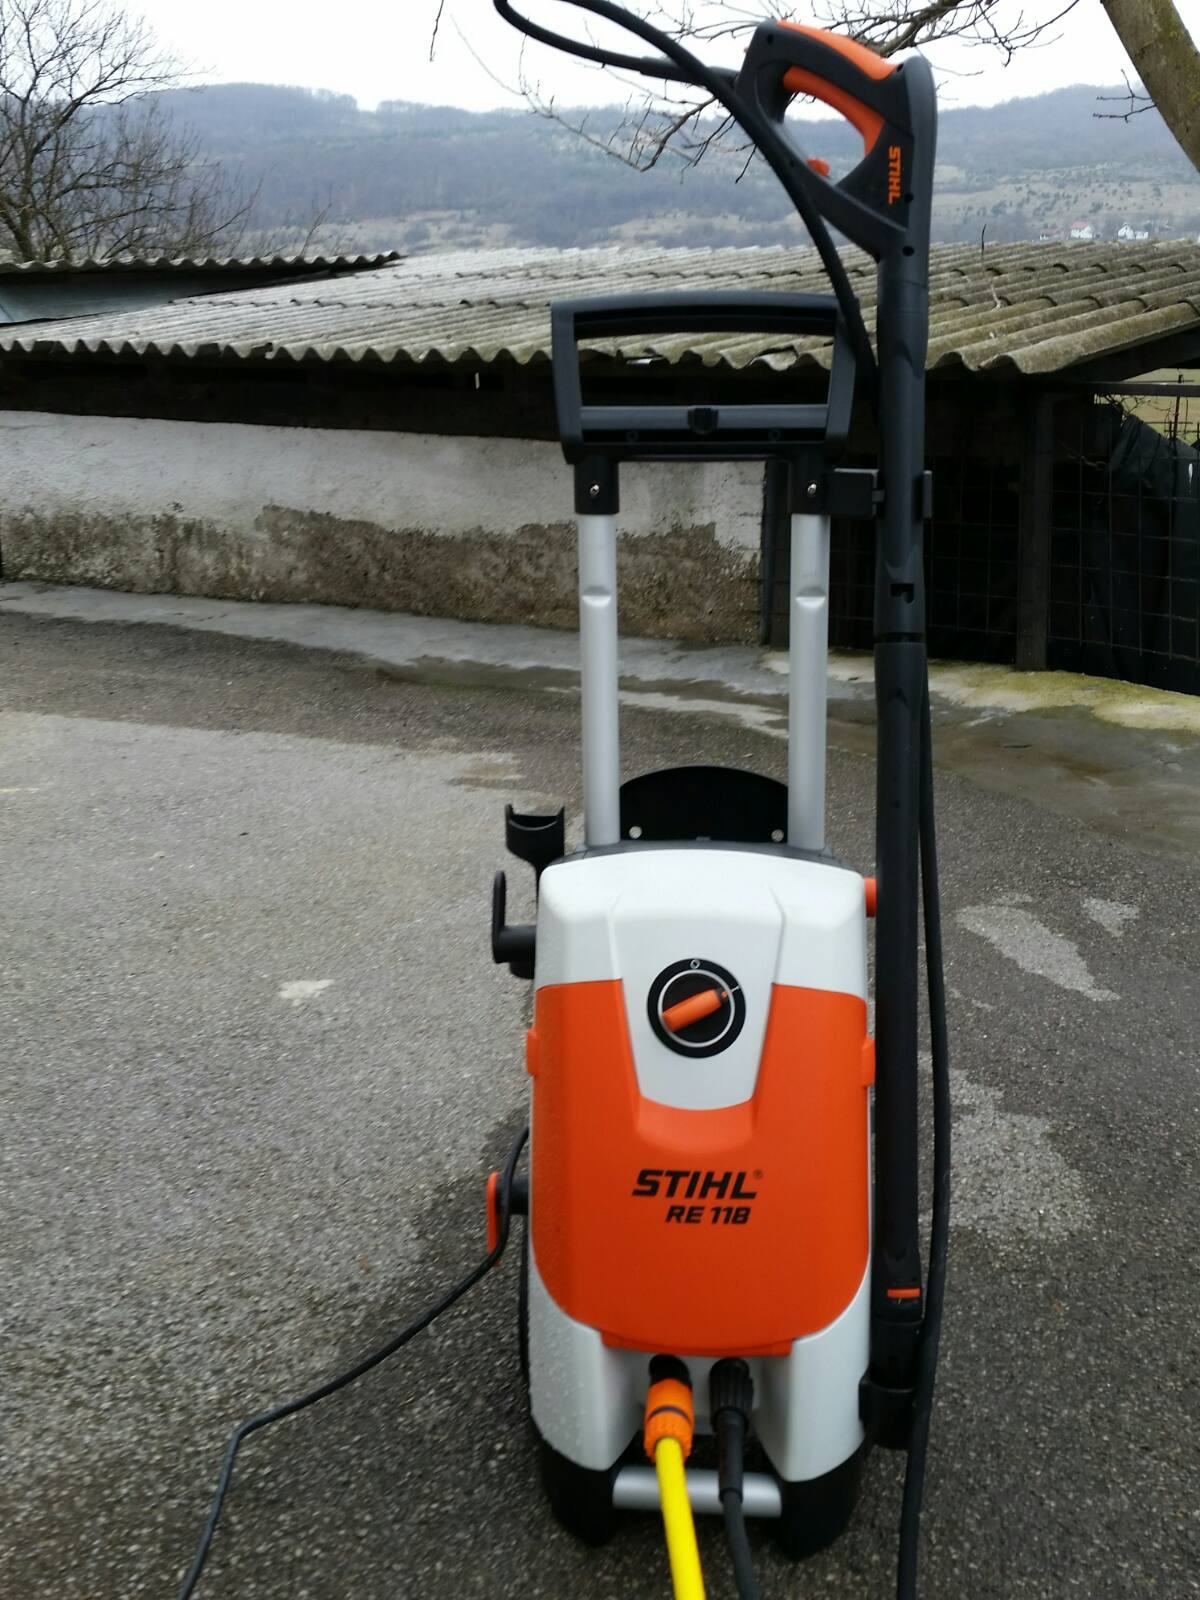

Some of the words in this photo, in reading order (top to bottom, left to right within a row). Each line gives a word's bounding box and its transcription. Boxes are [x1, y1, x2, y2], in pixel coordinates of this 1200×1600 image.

[888, 145, 901, 205] STIHL
[631, 1169, 757, 1200] STIHL
[665, 1205, 704, 1224] RE
[711, 1206, 751, 1225] 118
